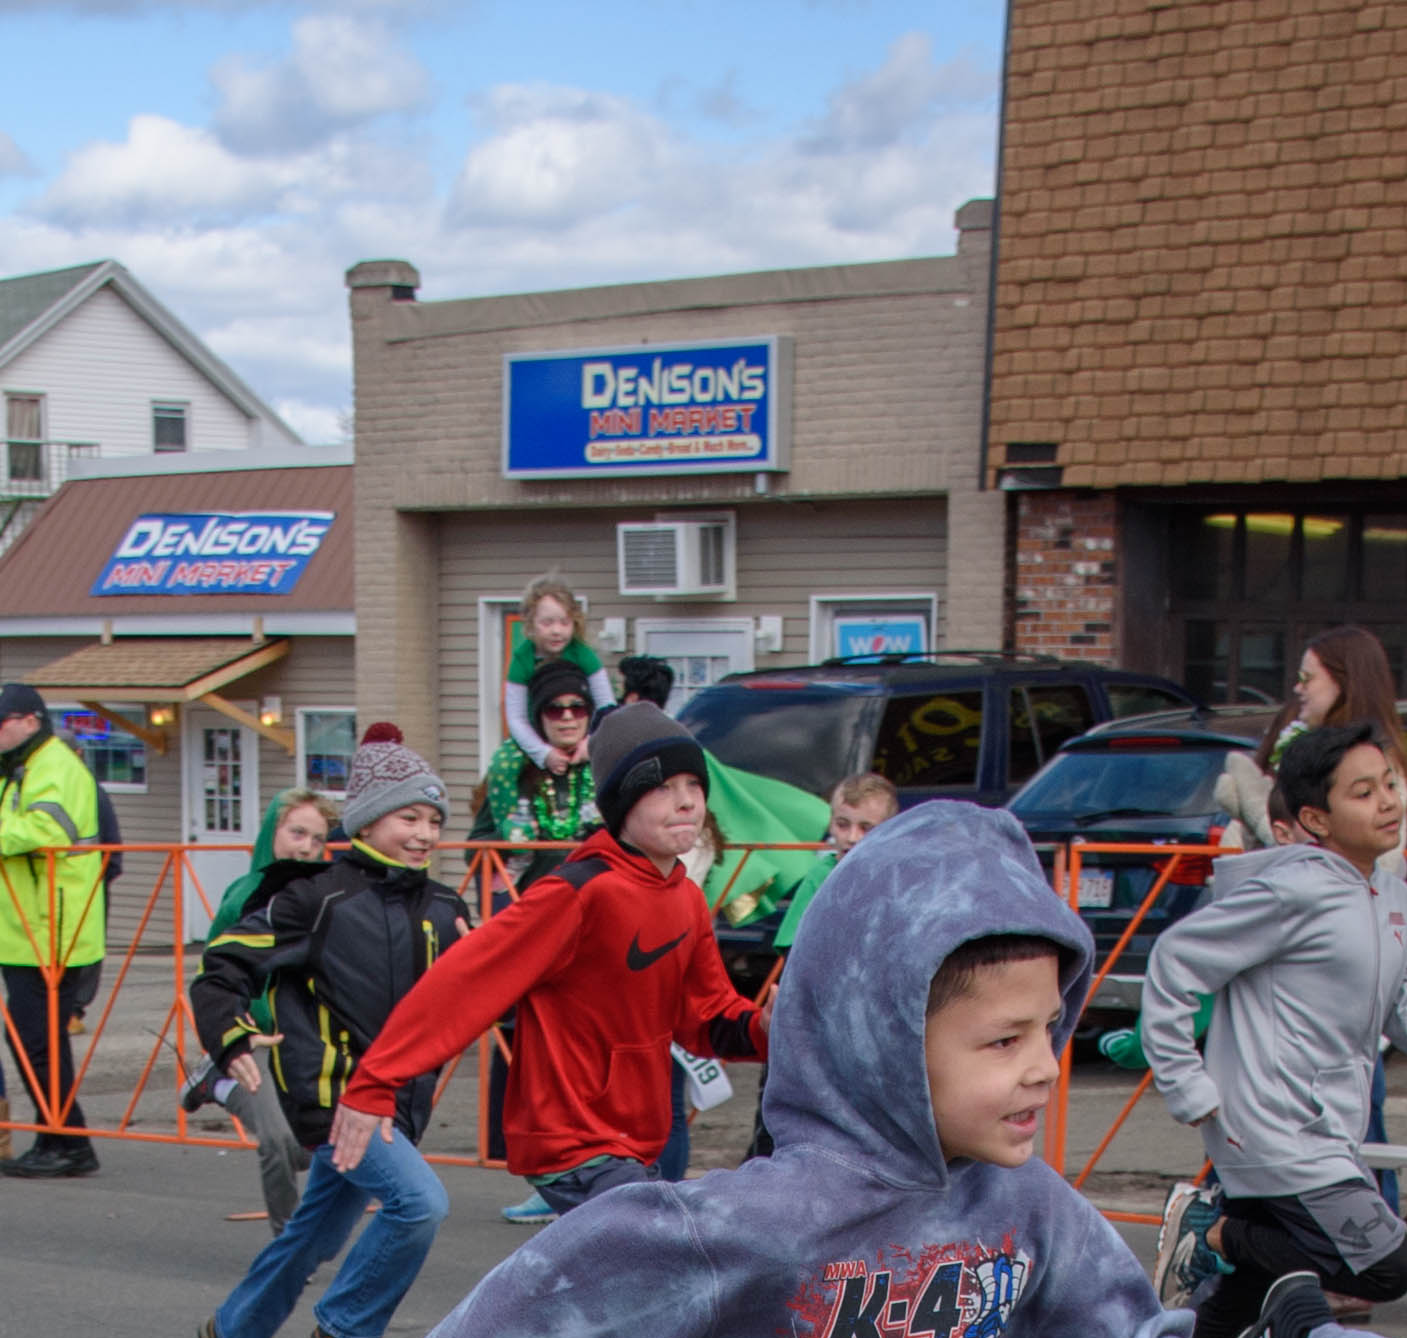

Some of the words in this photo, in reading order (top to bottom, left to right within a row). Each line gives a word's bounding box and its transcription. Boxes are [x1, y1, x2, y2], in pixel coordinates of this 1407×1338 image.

[589, 406, 642, 439] MINI
[648, 402, 757, 437] MARKET
[102, 561, 172, 590] MINI
[166, 560, 297, 588] MARKET
[823, 1260, 868, 1281] MWA
